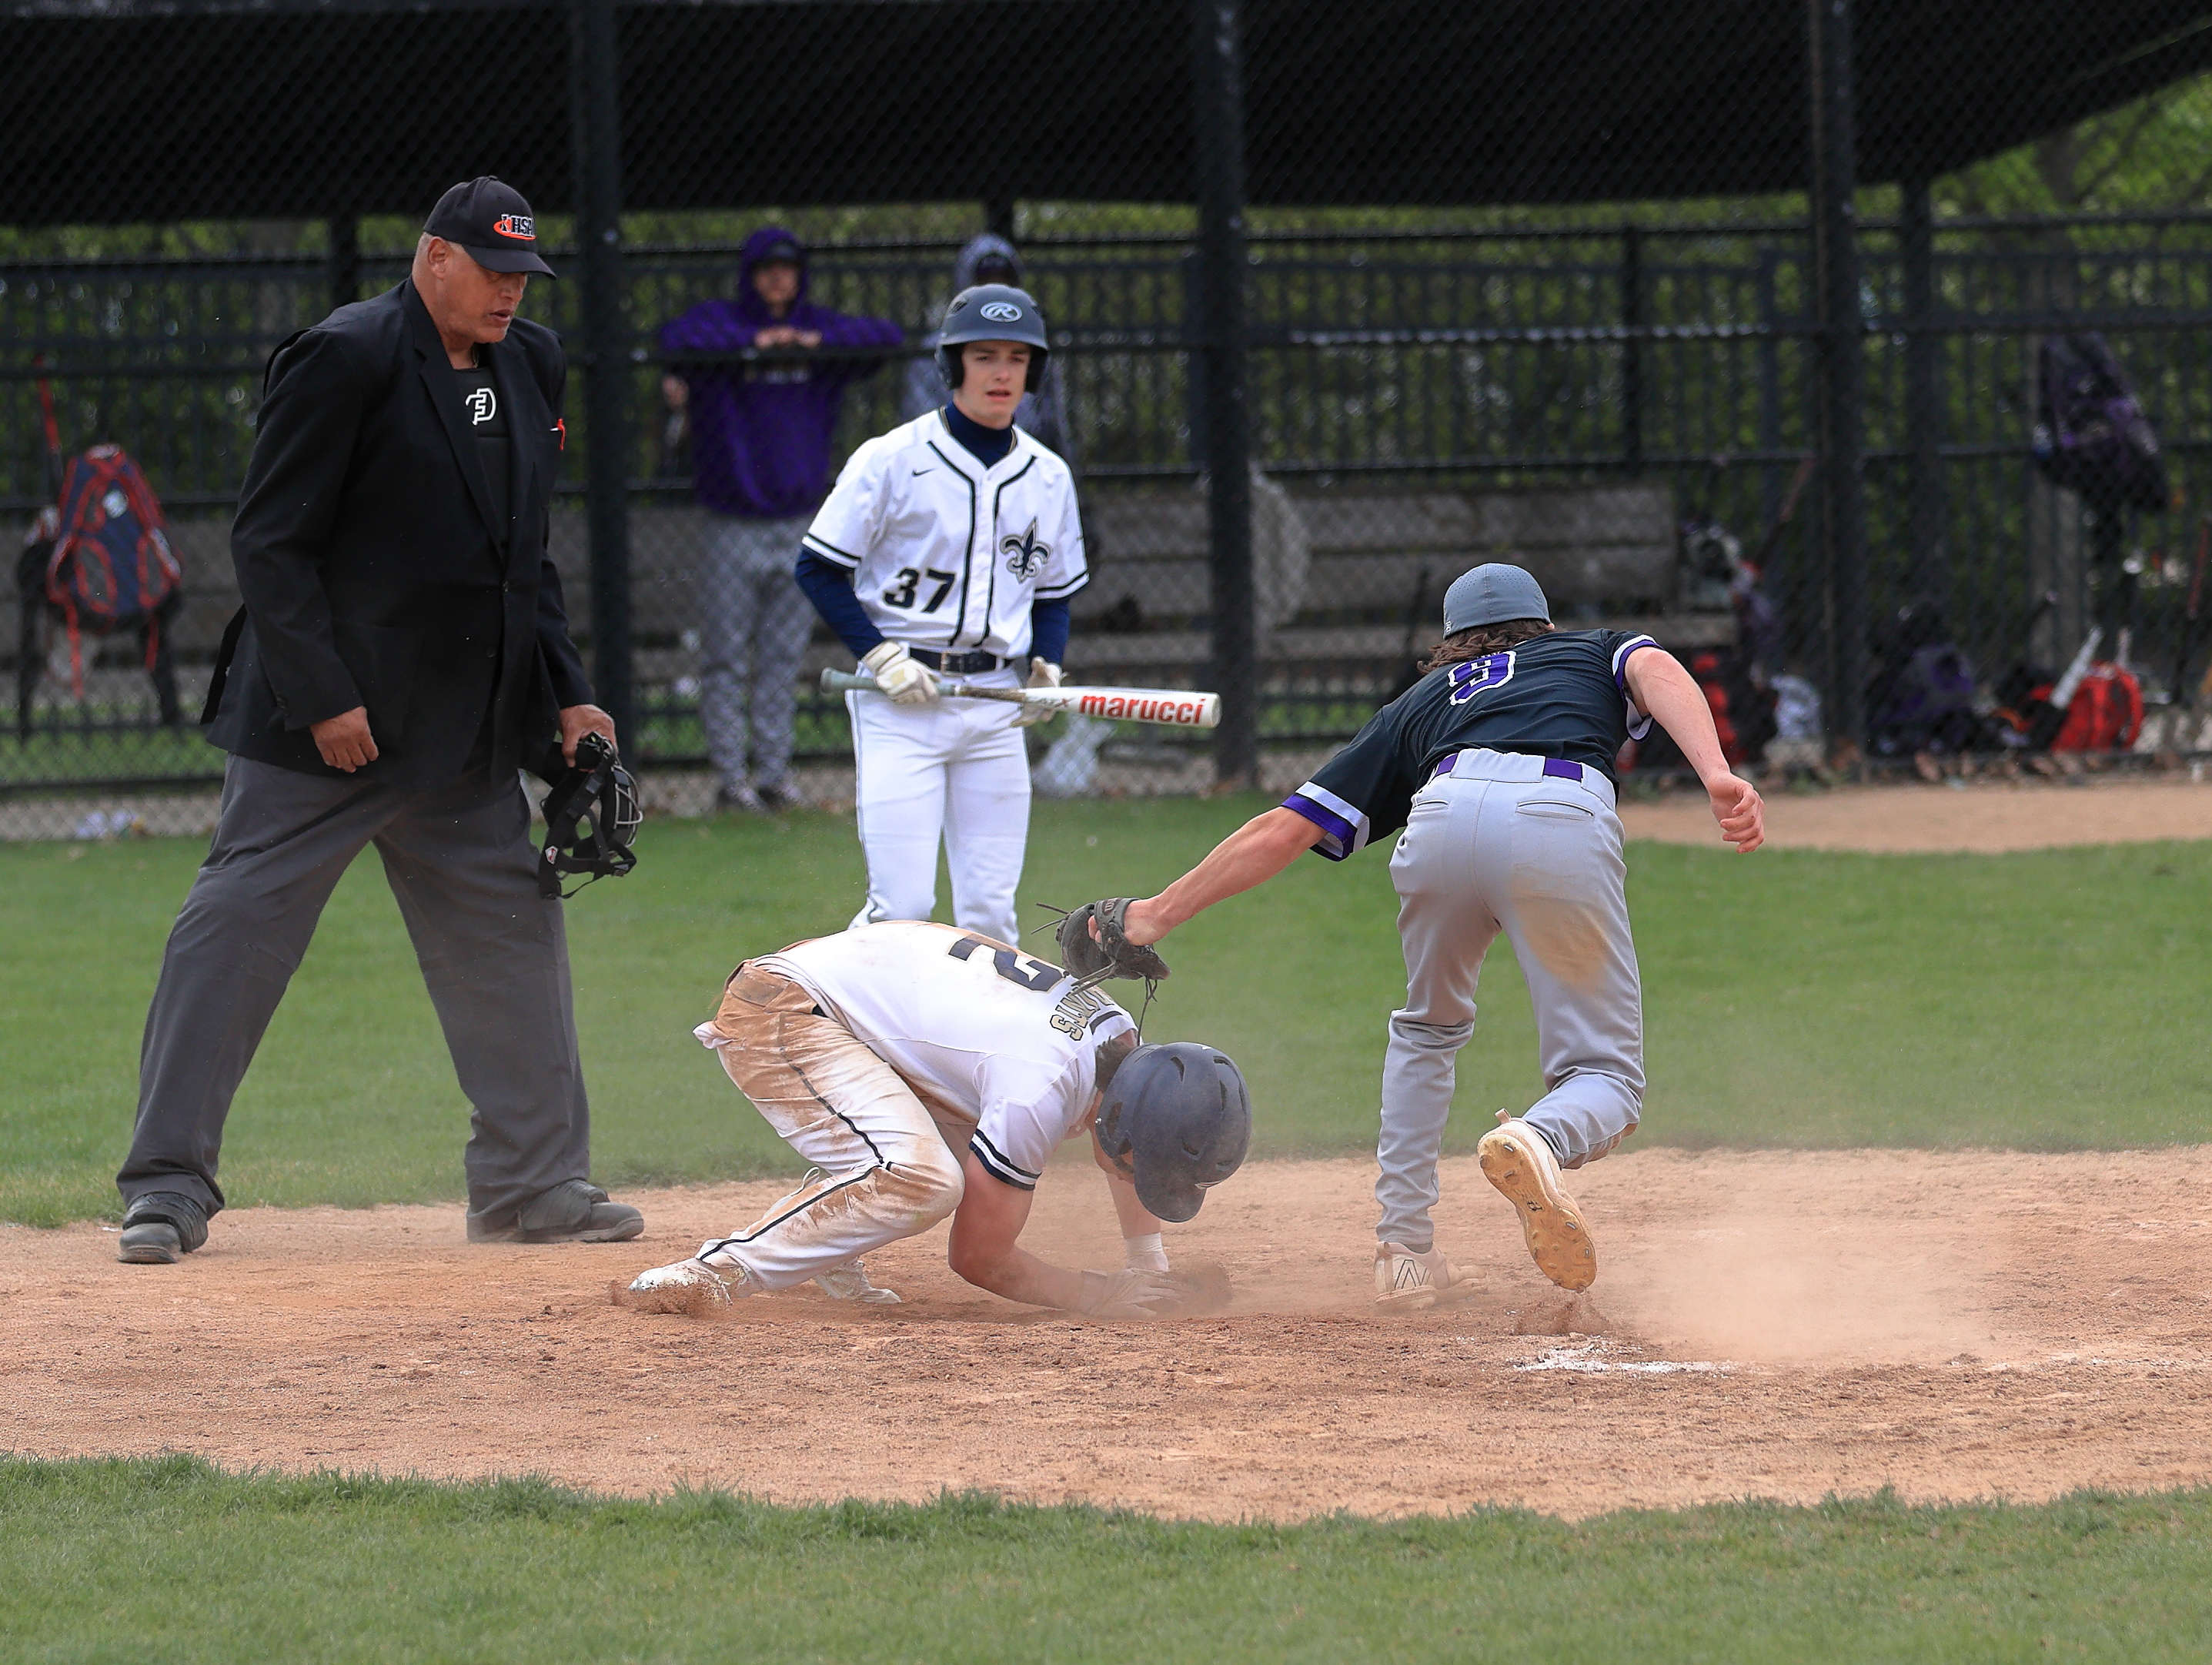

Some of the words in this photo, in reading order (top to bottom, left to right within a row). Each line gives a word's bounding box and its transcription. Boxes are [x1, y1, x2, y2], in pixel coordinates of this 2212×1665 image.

[881, 567, 956, 614] 37
[1079, 695, 1206, 724] marucci
[946, 932, 1065, 994] 2
